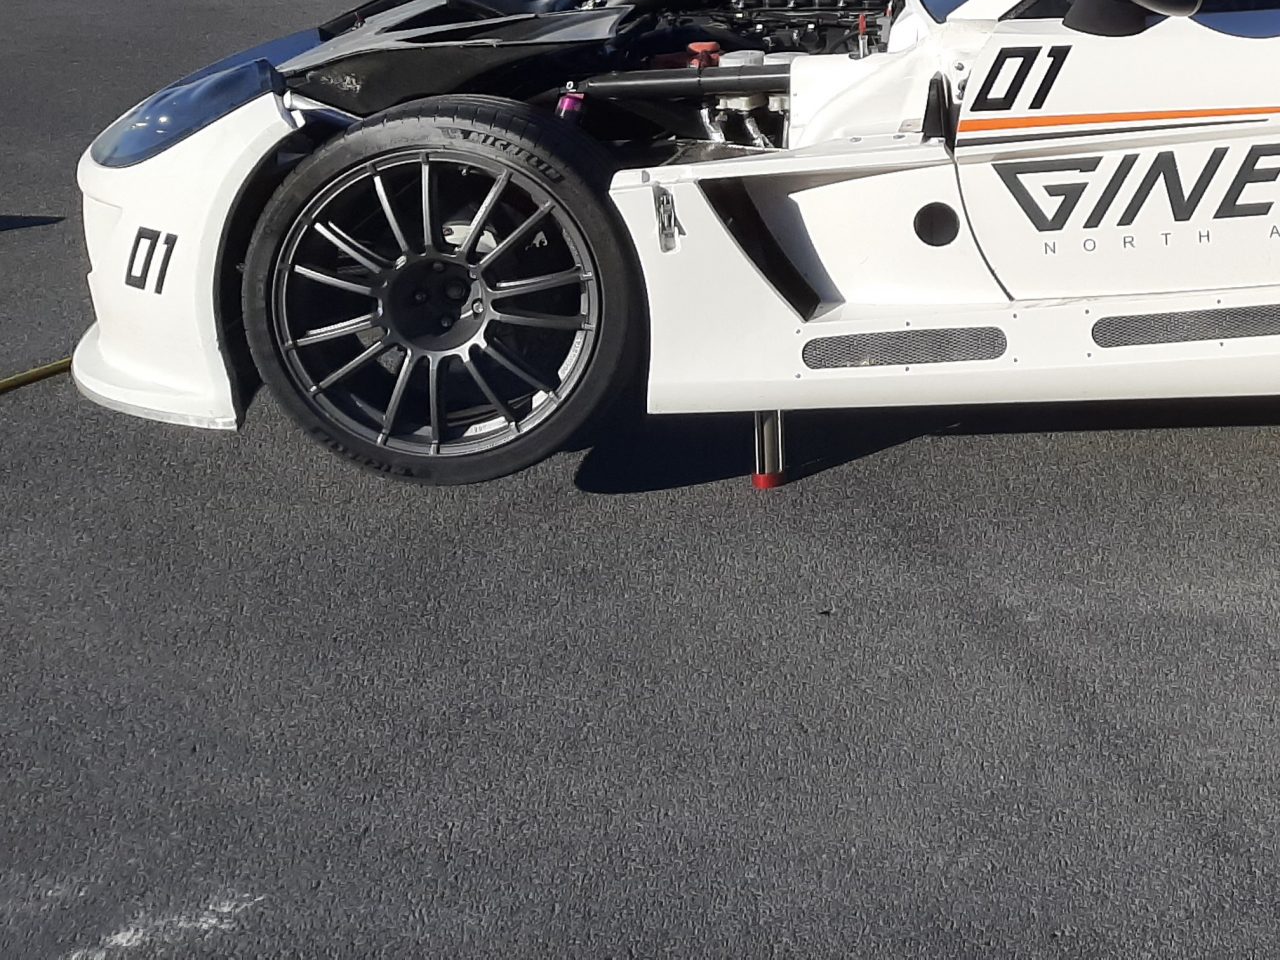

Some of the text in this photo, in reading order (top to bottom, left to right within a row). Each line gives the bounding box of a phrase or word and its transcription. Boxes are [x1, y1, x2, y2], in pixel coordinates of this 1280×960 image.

[969, 45, 1073, 112] 01
[125, 225, 178, 295] 01
[1043, 230, 1211, 255] NORTH
